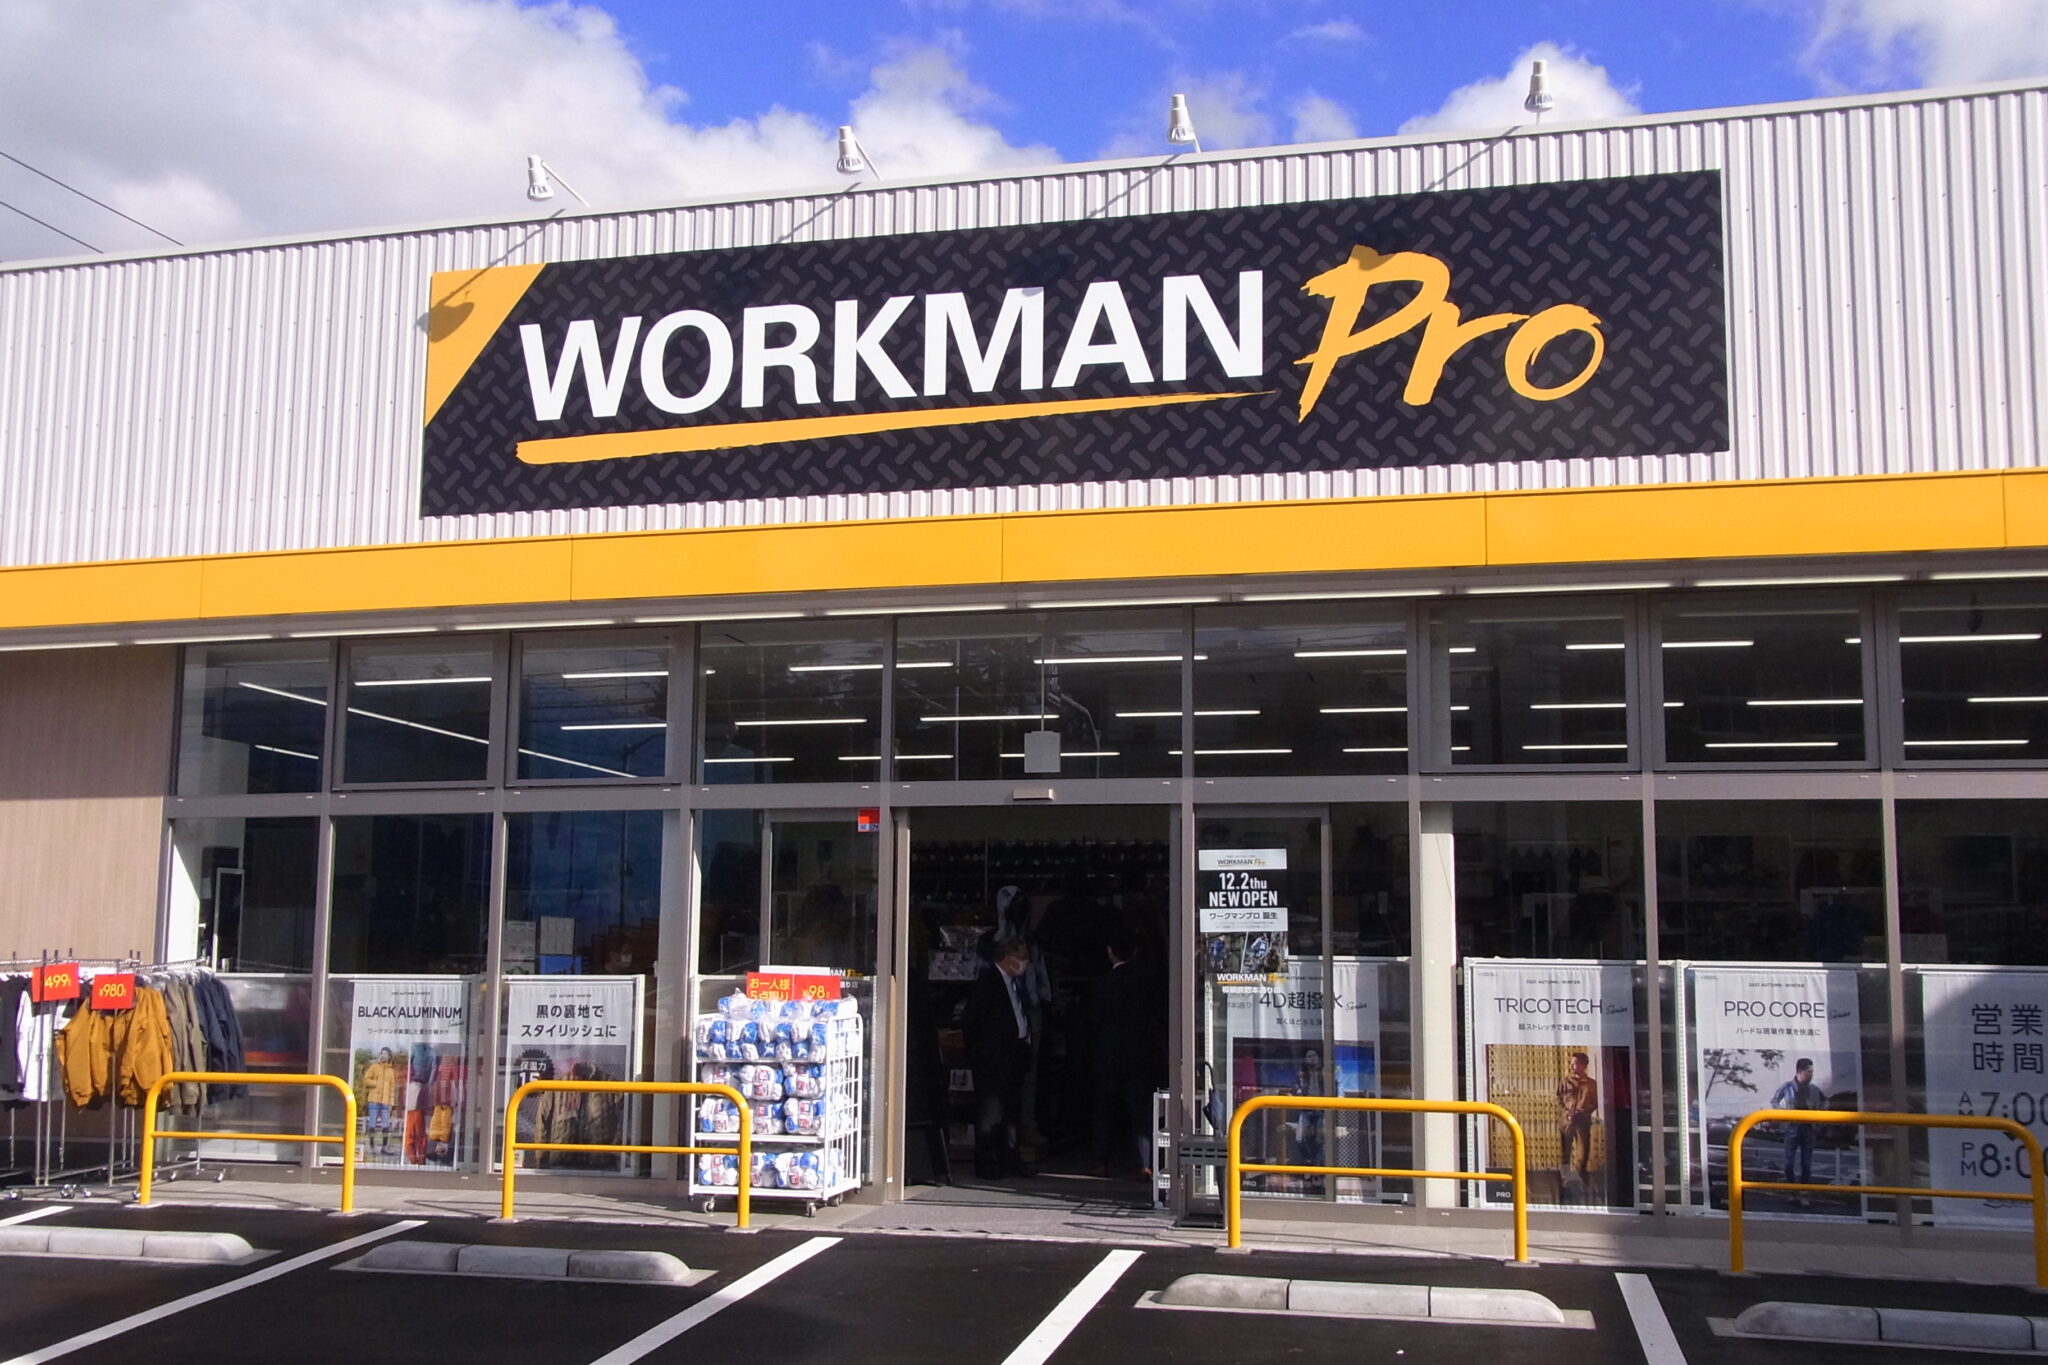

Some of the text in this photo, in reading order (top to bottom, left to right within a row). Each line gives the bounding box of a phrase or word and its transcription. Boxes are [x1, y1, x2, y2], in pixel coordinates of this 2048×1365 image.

[519, 244, 1604, 423] WORKMAN Pro
[1209, 890, 1278, 907] NEW OPEN
[1209, 912, 1260, 920] ワークマンプロ
[749, 978, 790, 991] お一人様
[1216, 972, 1266, 983] WORKMAN
[358, 1005, 462, 1019] BLACK ALUMINIUM
[536, 1004, 604, 1019] 黒の裏地で
[1494, 997, 1551, 1014] TRICO
[1554, 998, 1603, 1015] TECH
[1724, 1001, 1766, 1017] PRO
[1769, 1001, 1826, 1019] CORE
[1971, 1003, 2044, 1036] 営業
[520, 1024, 617, 1038] スタイリッシュに
[1972, 1041, 2044, 1075] 時間
[1980, 1143, 2048, 1179] 8:0
